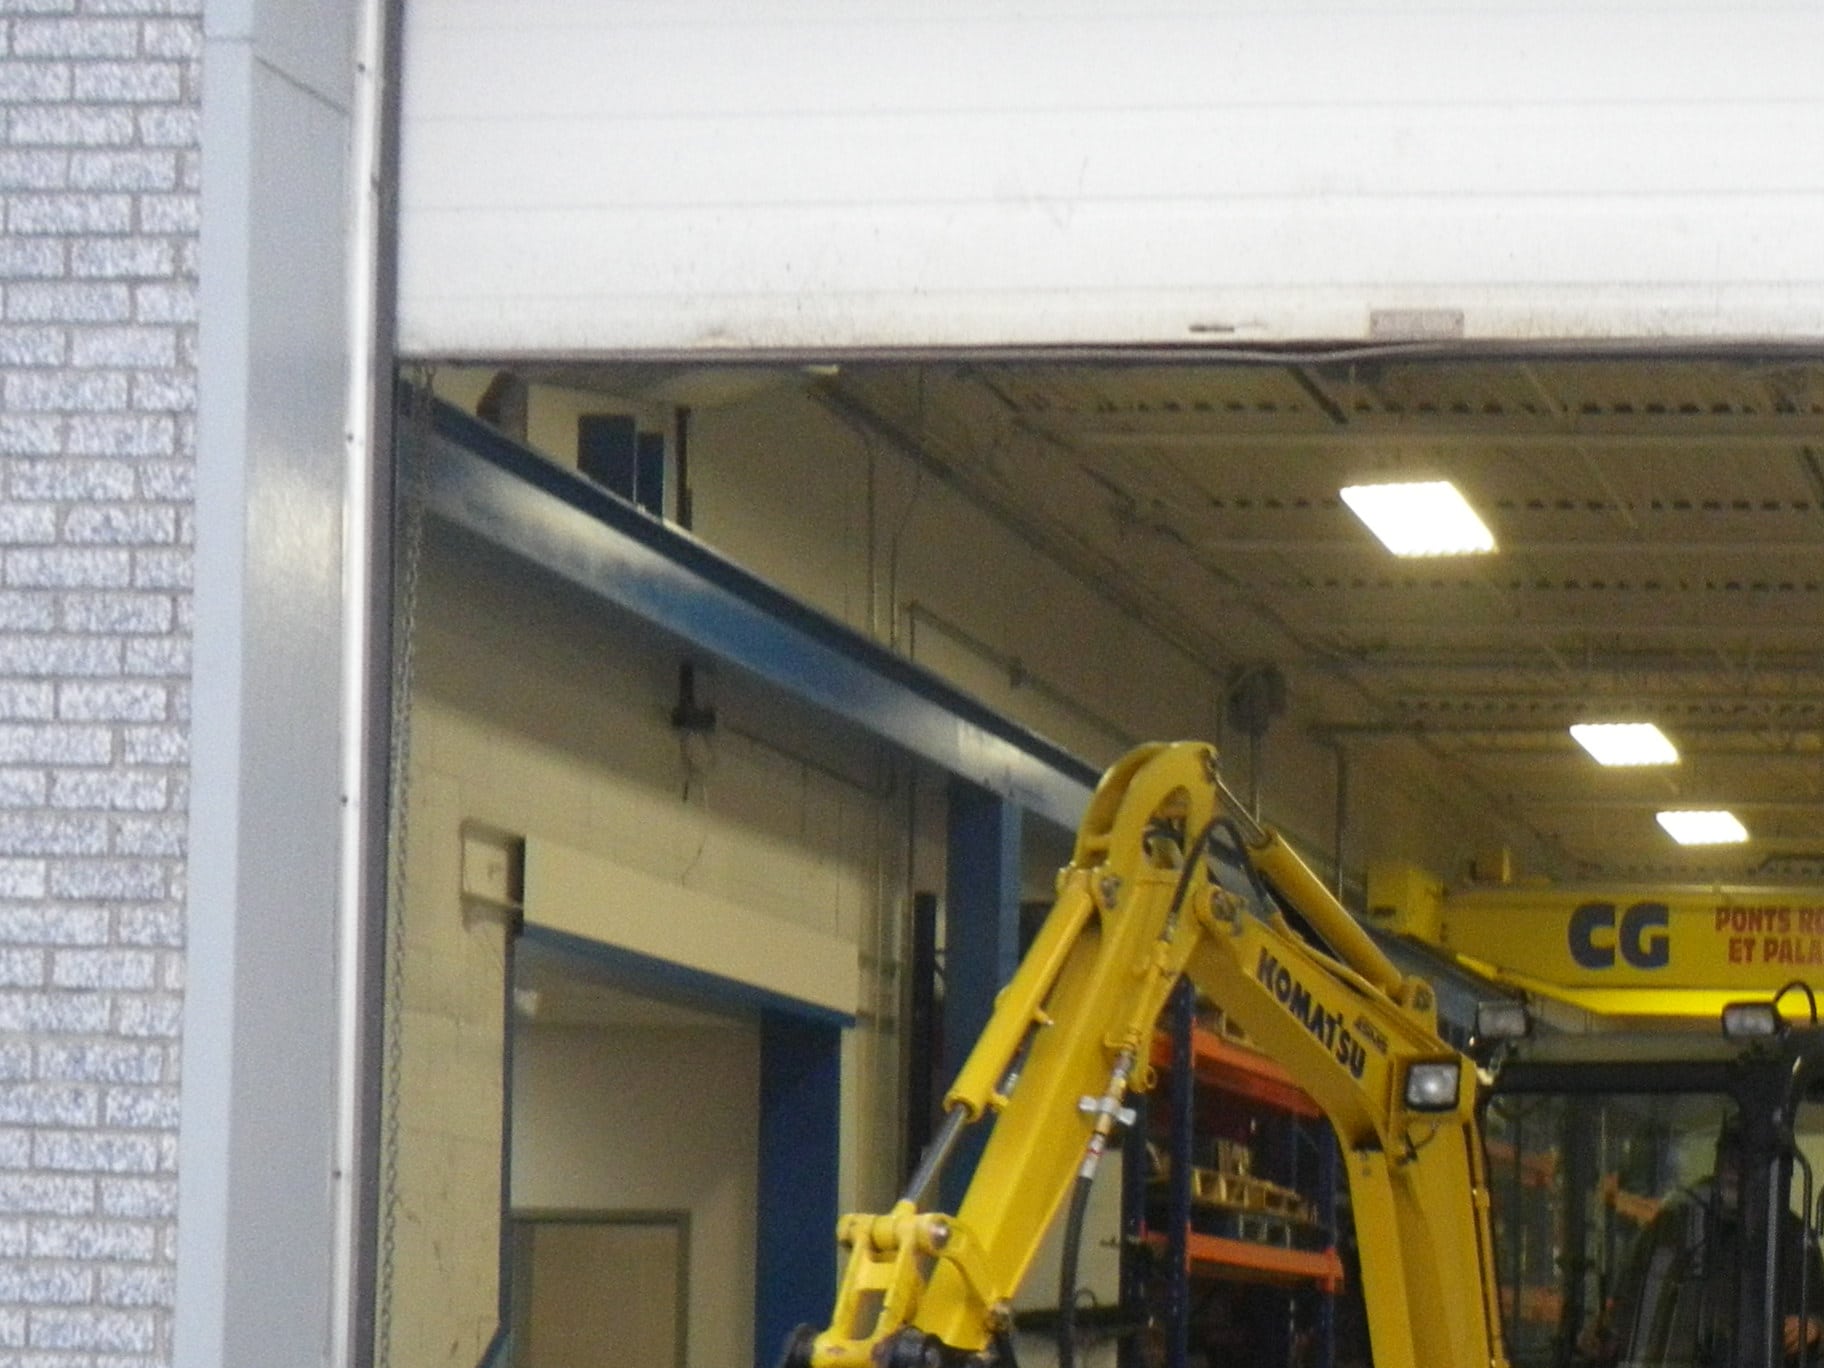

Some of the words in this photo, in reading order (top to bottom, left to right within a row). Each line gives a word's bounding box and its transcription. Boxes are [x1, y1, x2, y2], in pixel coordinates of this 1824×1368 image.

[1568, 903, 1670, 970] CG
[1714, 906, 1792, 933] PONTS
[1728, 937, 1757, 964] ET
[1257, 947, 1367, 1080] KOMATSU
